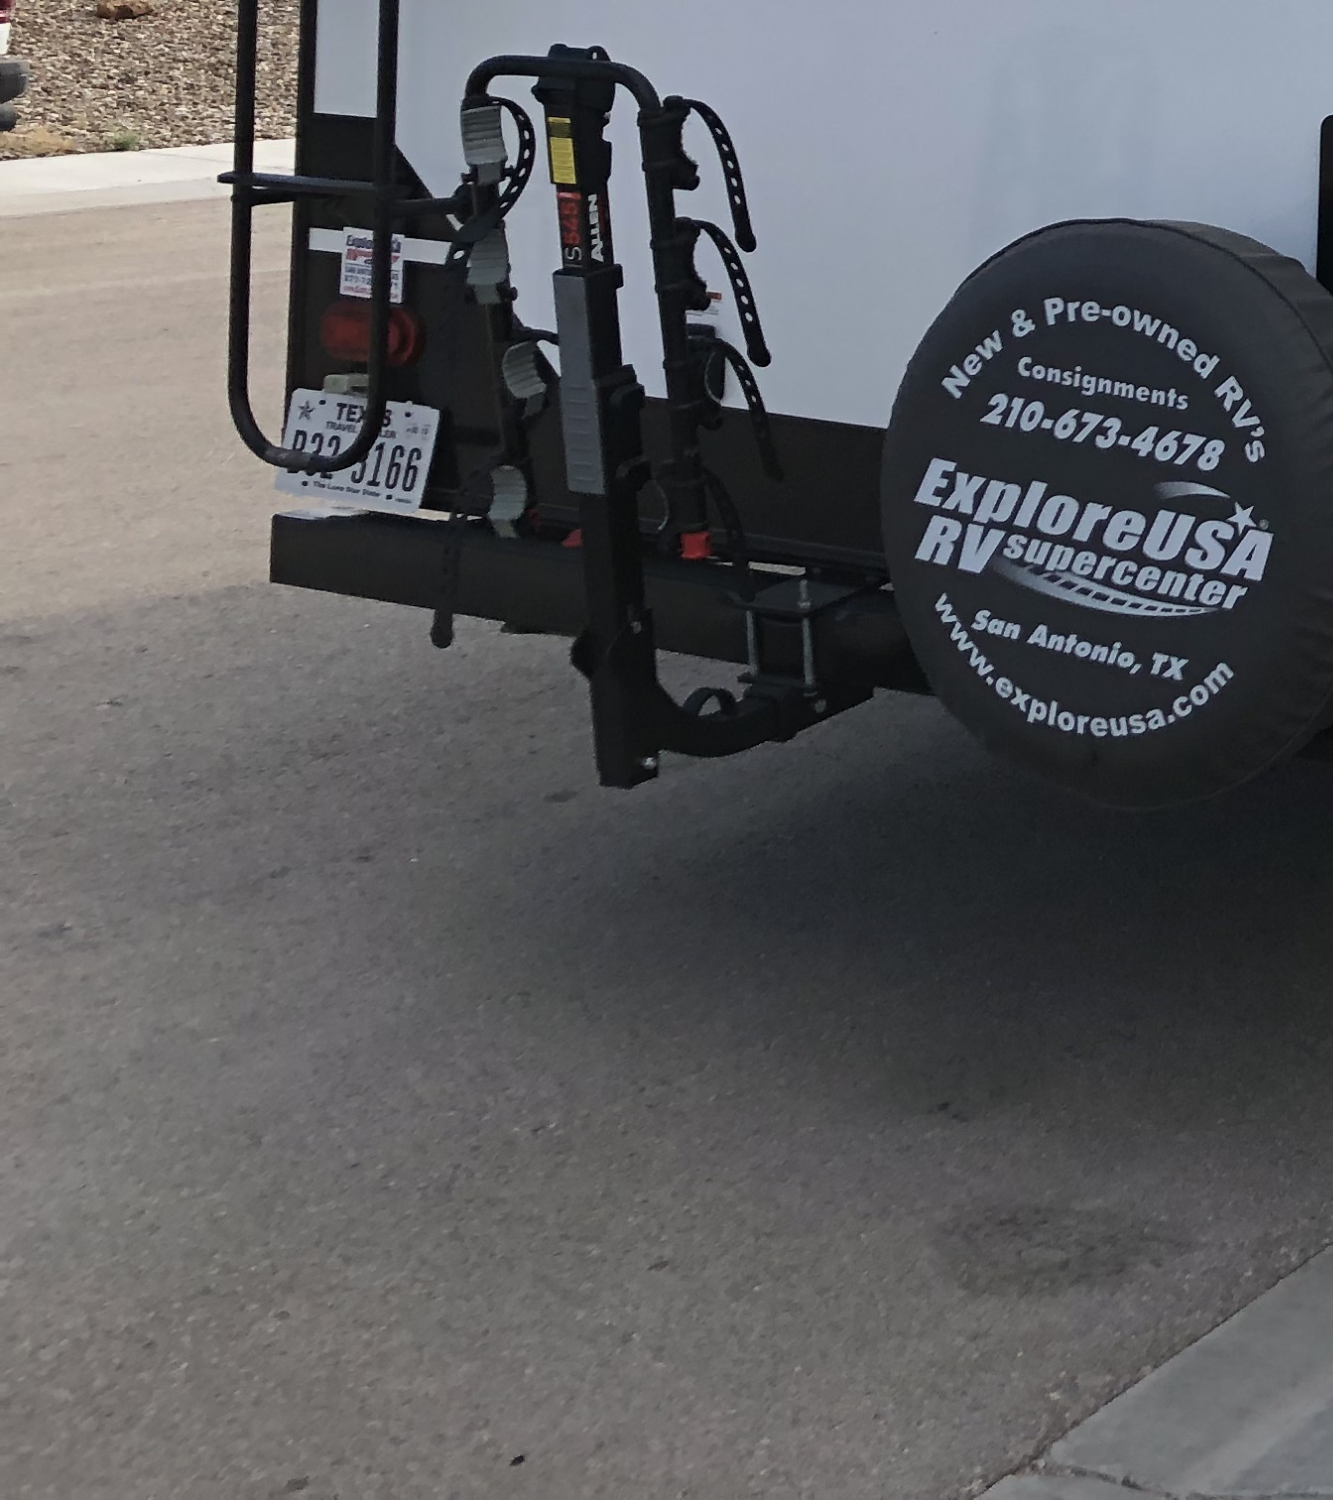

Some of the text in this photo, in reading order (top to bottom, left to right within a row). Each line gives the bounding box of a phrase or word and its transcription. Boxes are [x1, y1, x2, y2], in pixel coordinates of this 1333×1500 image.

[588, 194, 605, 263] ALLEN
[336, 402, 392, 427] TEXS
[941, 297, 1266, 463] New & Pre-owned RV's
[1017, 356, 1188, 410] Consignments
[326, 421, 358, 433] TRAVEL
[979, 393, 1225, 471] 210-673-4678
[913, 457, 1274, 582] ExploreUSA
[914, 515, 1248, 610] RV supercenter
[935, 592, 1235, 737] www.exploreusa.com
[971, 609, 1189, 681] San Antonio, TX
